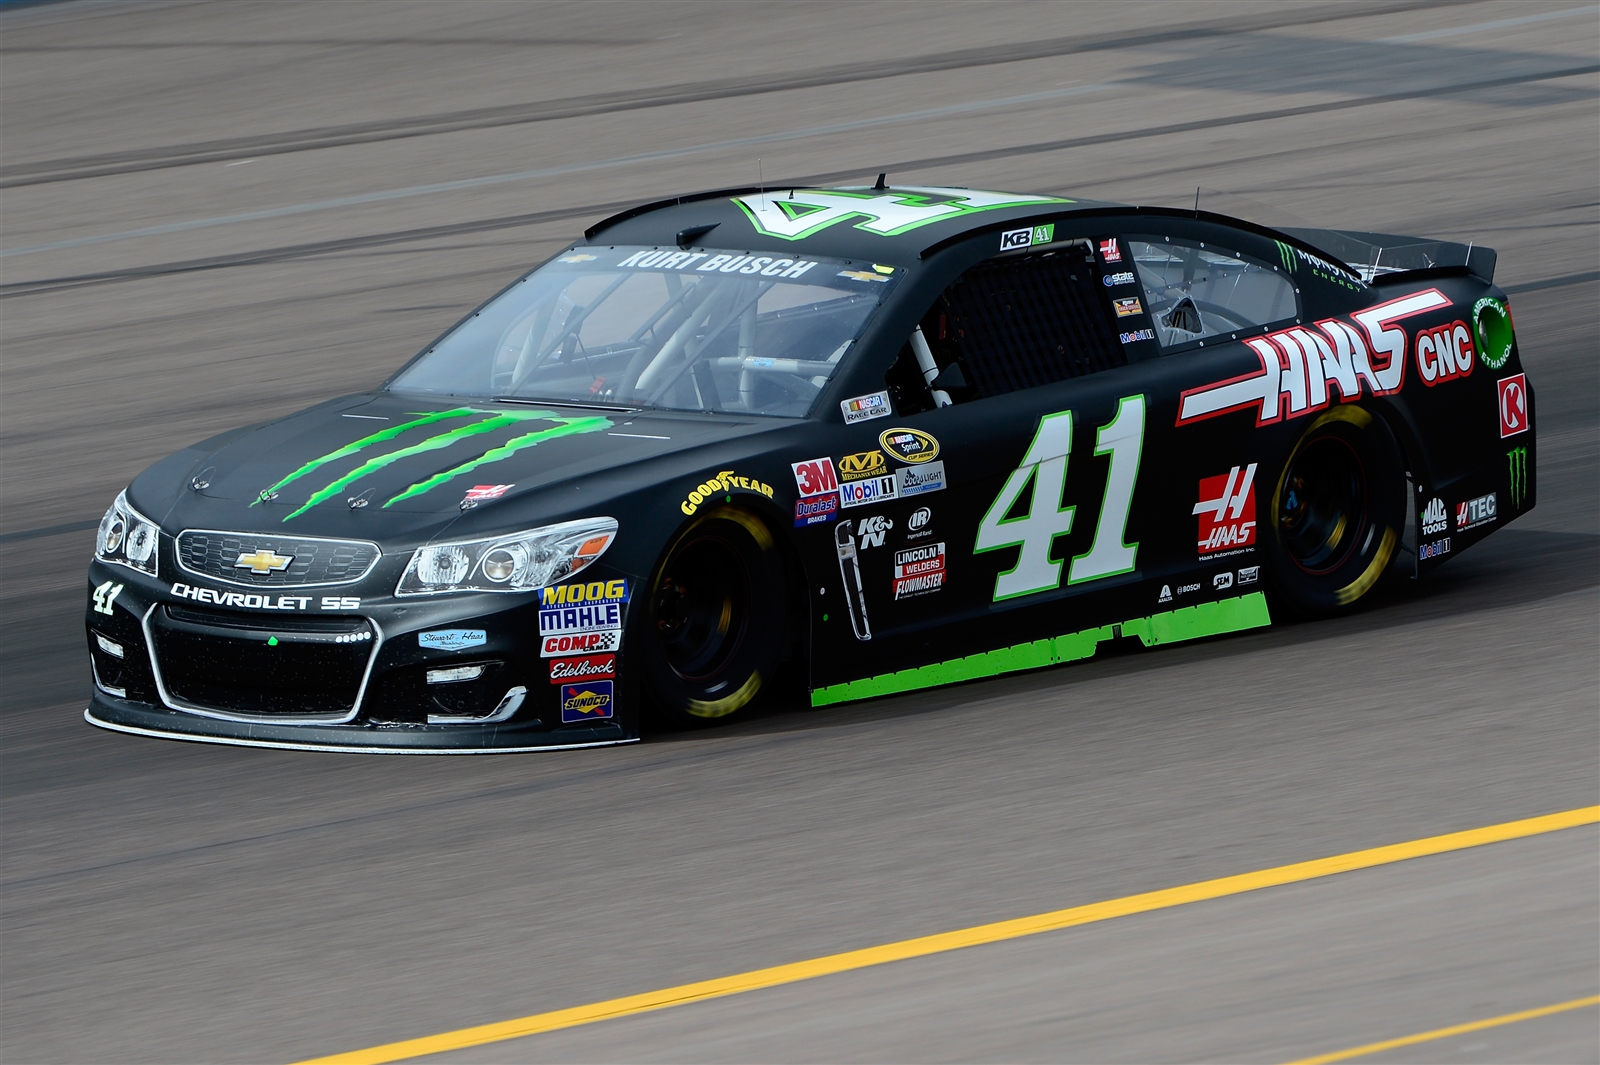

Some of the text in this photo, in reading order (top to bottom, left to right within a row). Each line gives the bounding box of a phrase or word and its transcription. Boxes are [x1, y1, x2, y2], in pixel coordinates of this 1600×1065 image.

[1003, 226, 1050, 248] KB 41
[617, 251, 818, 278] KURT BUSCH
[1112, 272, 1135, 282] state
[1313, 269, 1361, 292] ENERGY
[1473, 298, 1506, 325] AMERICAN
[1120, 330, 1146, 344] Mobil
[1177, 288, 1452, 427] HAAS
[1417, 322, 1473, 384] CNC
[1481, 343, 1512, 368] ETHANOL
[859, 396, 881, 410] NASCAR
[1505, 385, 1524, 425] K
[847, 407, 887, 420] RACE CAR
[894, 434, 914, 443] NASCAR
[901, 441, 920, 453] Sprint
[797, 460, 837, 495] 3M
[841, 466, 888, 481] MECHANIX WEAR
[904, 473, 924, 487] Coors
[924, 471, 942, 482] LIGHT
[681, 471, 774, 515] GOODYEAR
[843, 479, 879, 502] Mobil
[973, 393, 1146, 602] 41
[797, 496, 836, 516] Duralast
[1423, 497, 1447, 526] MAC
[807, 515, 827, 524] BRAKES
[912, 511, 928, 528] IR
[1422, 520, 1447, 535] TOOLS
[1198, 521, 1256, 549] HAAS
[897, 547, 936, 565] LINCOLN
[1214, 549, 1245, 558] Automation
[1420, 537, 1450, 560] Mobil 1
[906, 560, 940, 574] WELDERS
[170, 582, 361, 610] CHEVROLET SS
[542, 579, 625, 605] MOOG
[895, 572, 942, 600] FLOWMASTER
[1183, 583, 1200, 592] BOSCH
[93, 580, 124, 615] 41
[540, 605, 618, 631] MAHLE
[421, 632, 456, 643] Stewart
[462, 631, 484, 640] Haas
[545, 634, 601, 653] COMP
[583, 643, 610, 652] CAMS
[550, 659, 614, 679] Edelbrock
[566, 695, 608, 709] SUNOCO
